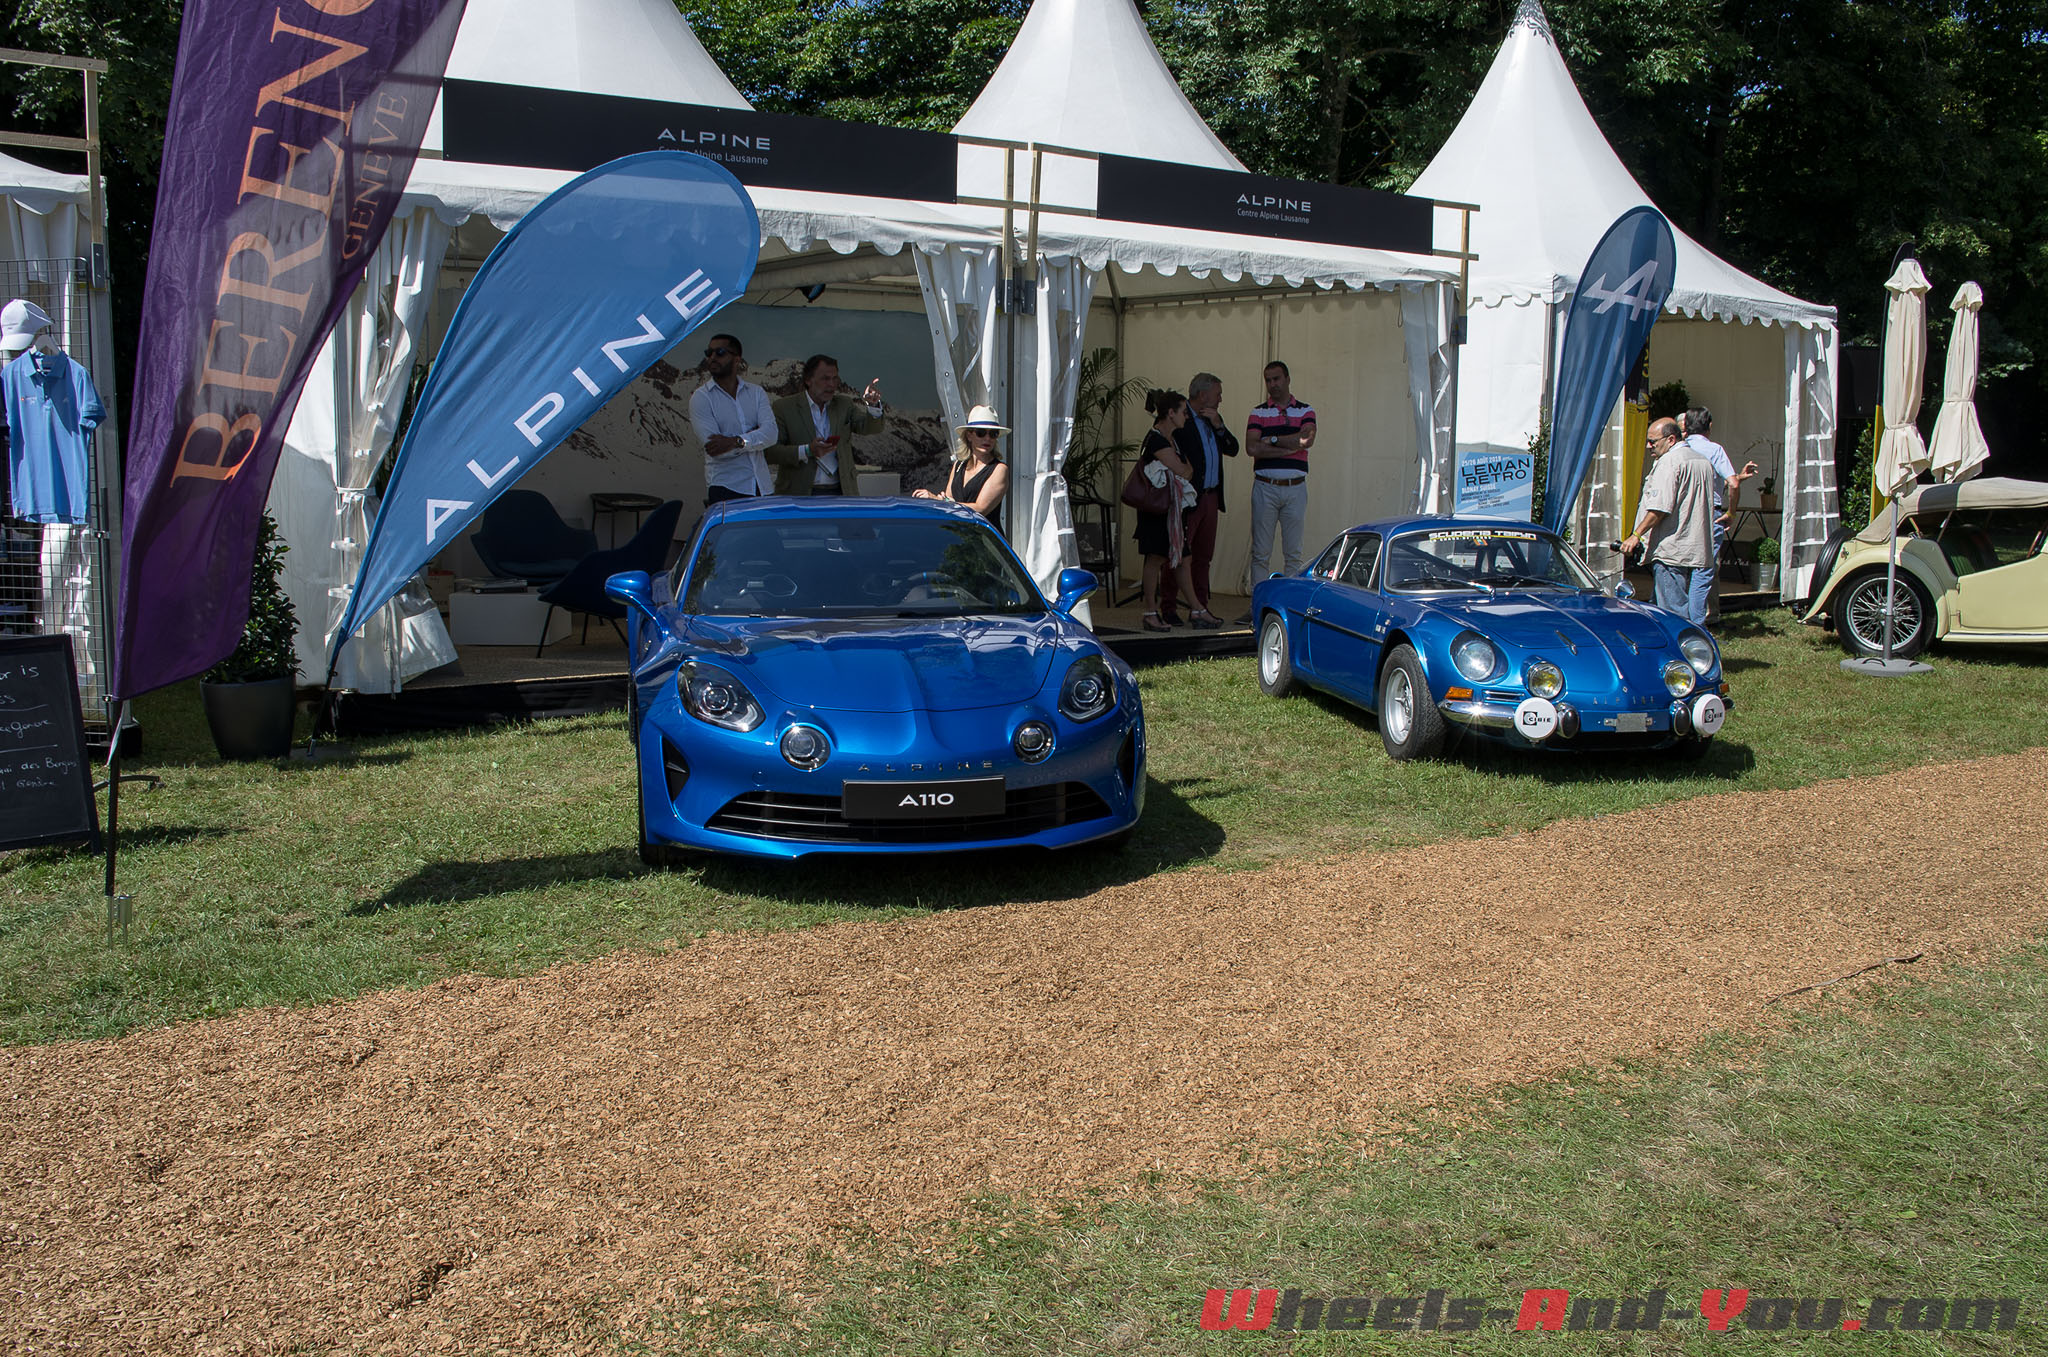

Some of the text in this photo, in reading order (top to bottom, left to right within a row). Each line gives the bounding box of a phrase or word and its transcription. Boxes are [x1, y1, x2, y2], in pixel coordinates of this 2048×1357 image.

[657, 128, 771, 150] ALPINE
[725, 152, 768, 165] Lausanne
[342, 92, 408, 260] GENEVE
[1236, 193, 1311, 212] ALPINE
[1237, 208, 1310, 224] Centre Alpine Lausanne
[170, 0, 374, 488] BEREN
[426, 268, 722, 546] ALPINE
[1461, 458, 1530, 477] LEMAN
[1465, 469, 1527, 487] RETRO
[858, 760, 993, 772] ALPINE
[898, 793, 954, 807] A110
